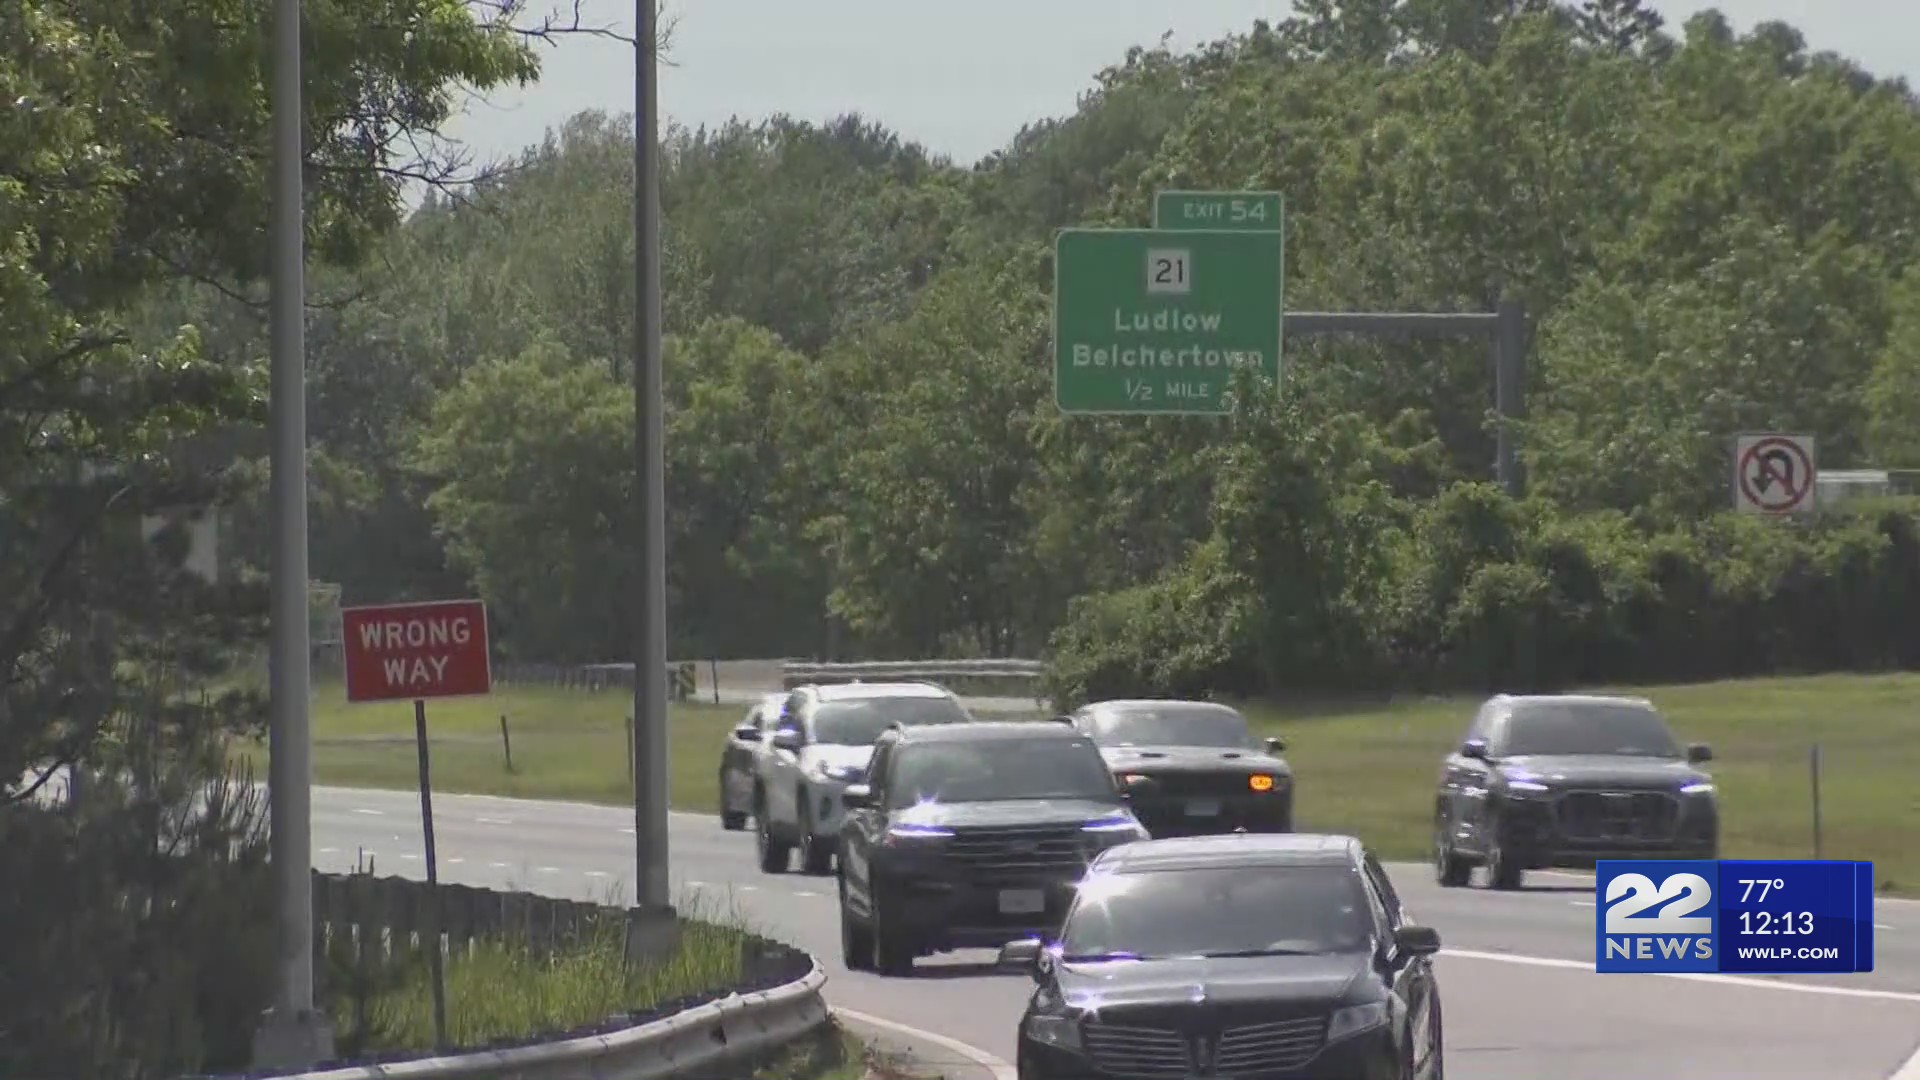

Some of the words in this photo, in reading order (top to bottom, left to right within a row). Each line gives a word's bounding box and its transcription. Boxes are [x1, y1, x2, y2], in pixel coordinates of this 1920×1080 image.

[1184, 203, 1223, 218] EXIT
[1231, 201, 1266, 221] 54
[1155, 259, 1183, 283] 21
[1115, 308, 1221, 331] Ludlow
[1166, 384, 1209, 397] MILE
[360, 617, 471, 649] WRONG
[384, 655, 449, 686] WAY
